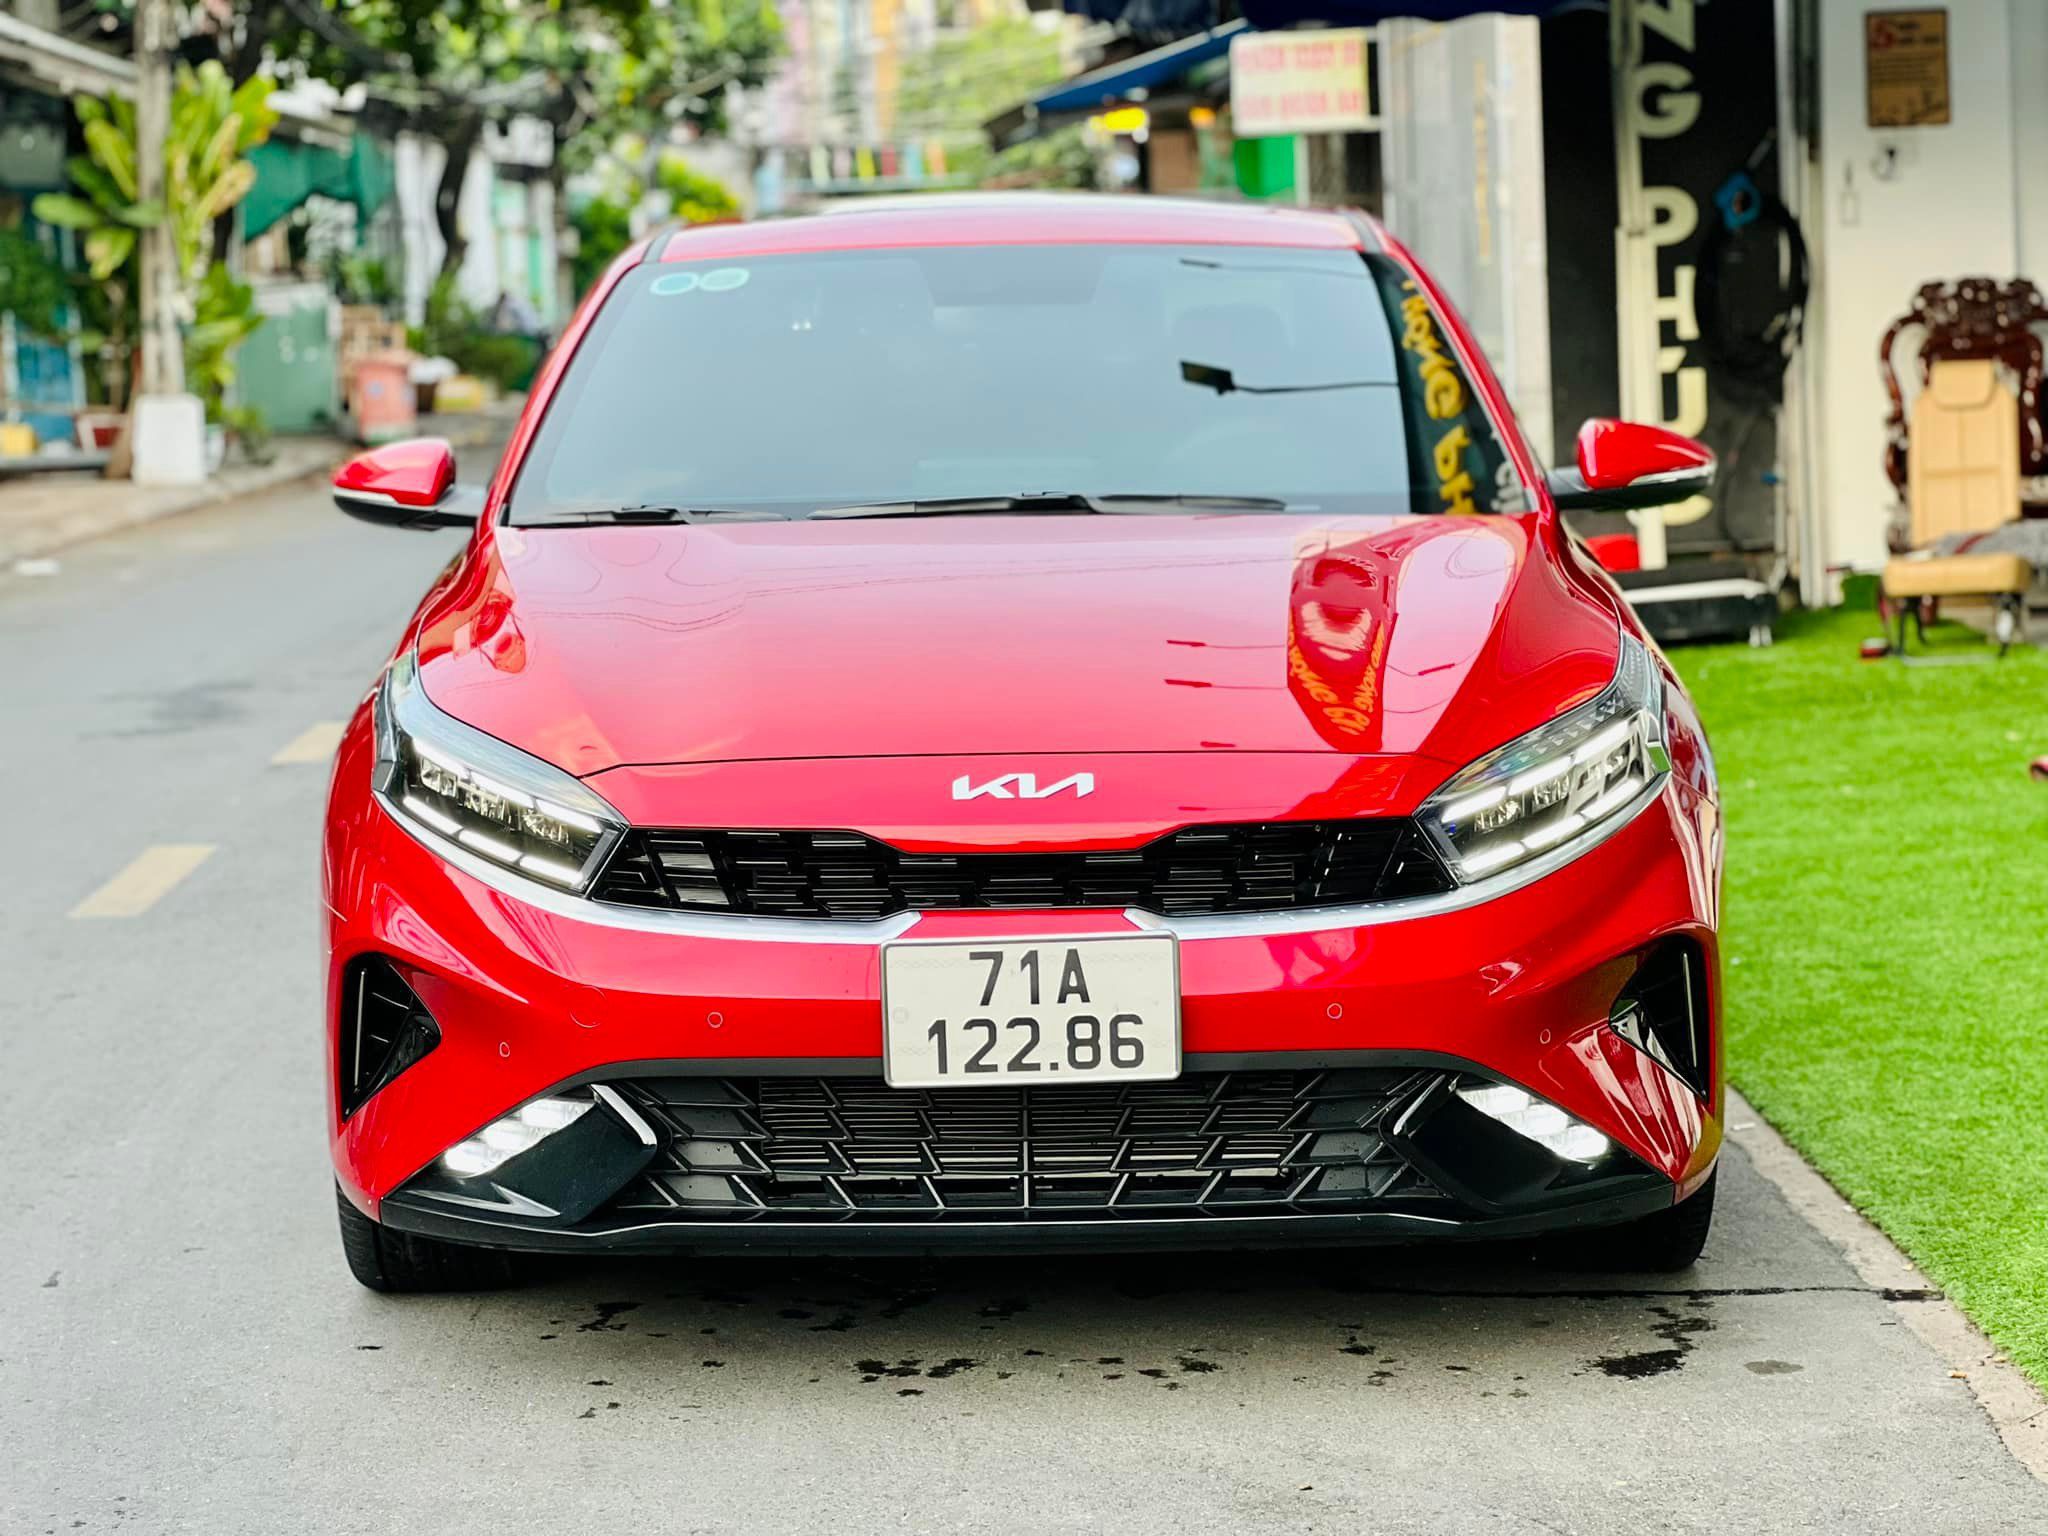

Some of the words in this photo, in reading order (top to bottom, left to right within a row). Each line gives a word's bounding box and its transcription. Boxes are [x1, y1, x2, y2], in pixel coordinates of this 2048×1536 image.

[952, 772, 1094, 801] KIA
[969, 948, 1091, 1007] 71A
[927, 1014, 1144, 1075] 122.86
